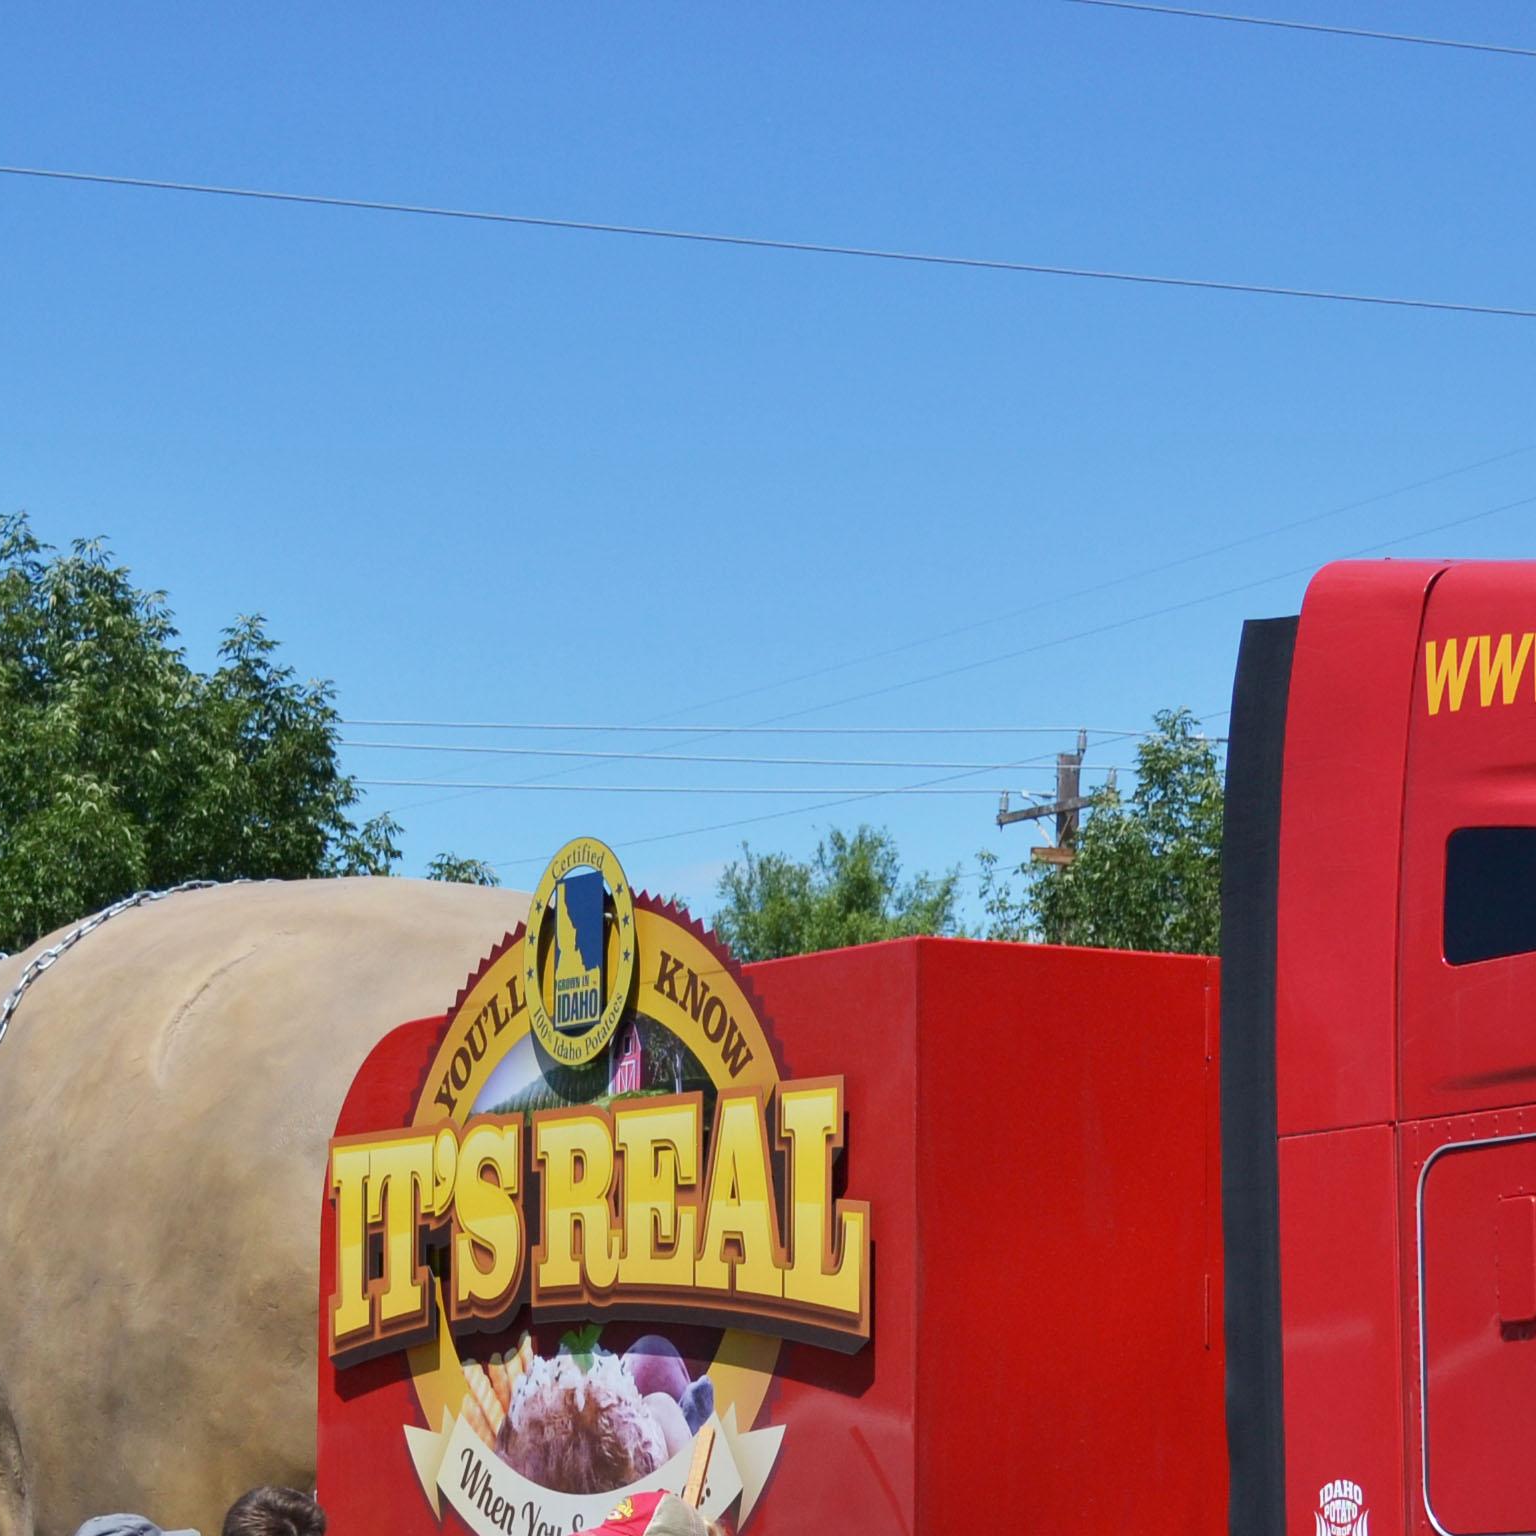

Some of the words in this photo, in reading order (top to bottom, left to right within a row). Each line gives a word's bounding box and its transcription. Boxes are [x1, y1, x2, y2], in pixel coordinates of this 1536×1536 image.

[551, 843, 605, 880] Certified
[557, 976, 581, 992] GROWN
[581, 974, 590, 988] IN
[557, 988, 598, 1023] IDAHO
[434, 975, 527, 1109] YOU'LL
[654, 950, 753, 1079] KNOW
[553, 1033, 582, 1060] Idaho
[585, 992, 624, 1057] Potatoes
[330, 1118, 522, 1342] IT'S
[534, 1080, 869, 1322] REAL
[460, 1447, 516, 1536] When
[1319, 1479, 1363, 1508] IDAHO
[1324, 1499, 1358, 1524] POTATO
